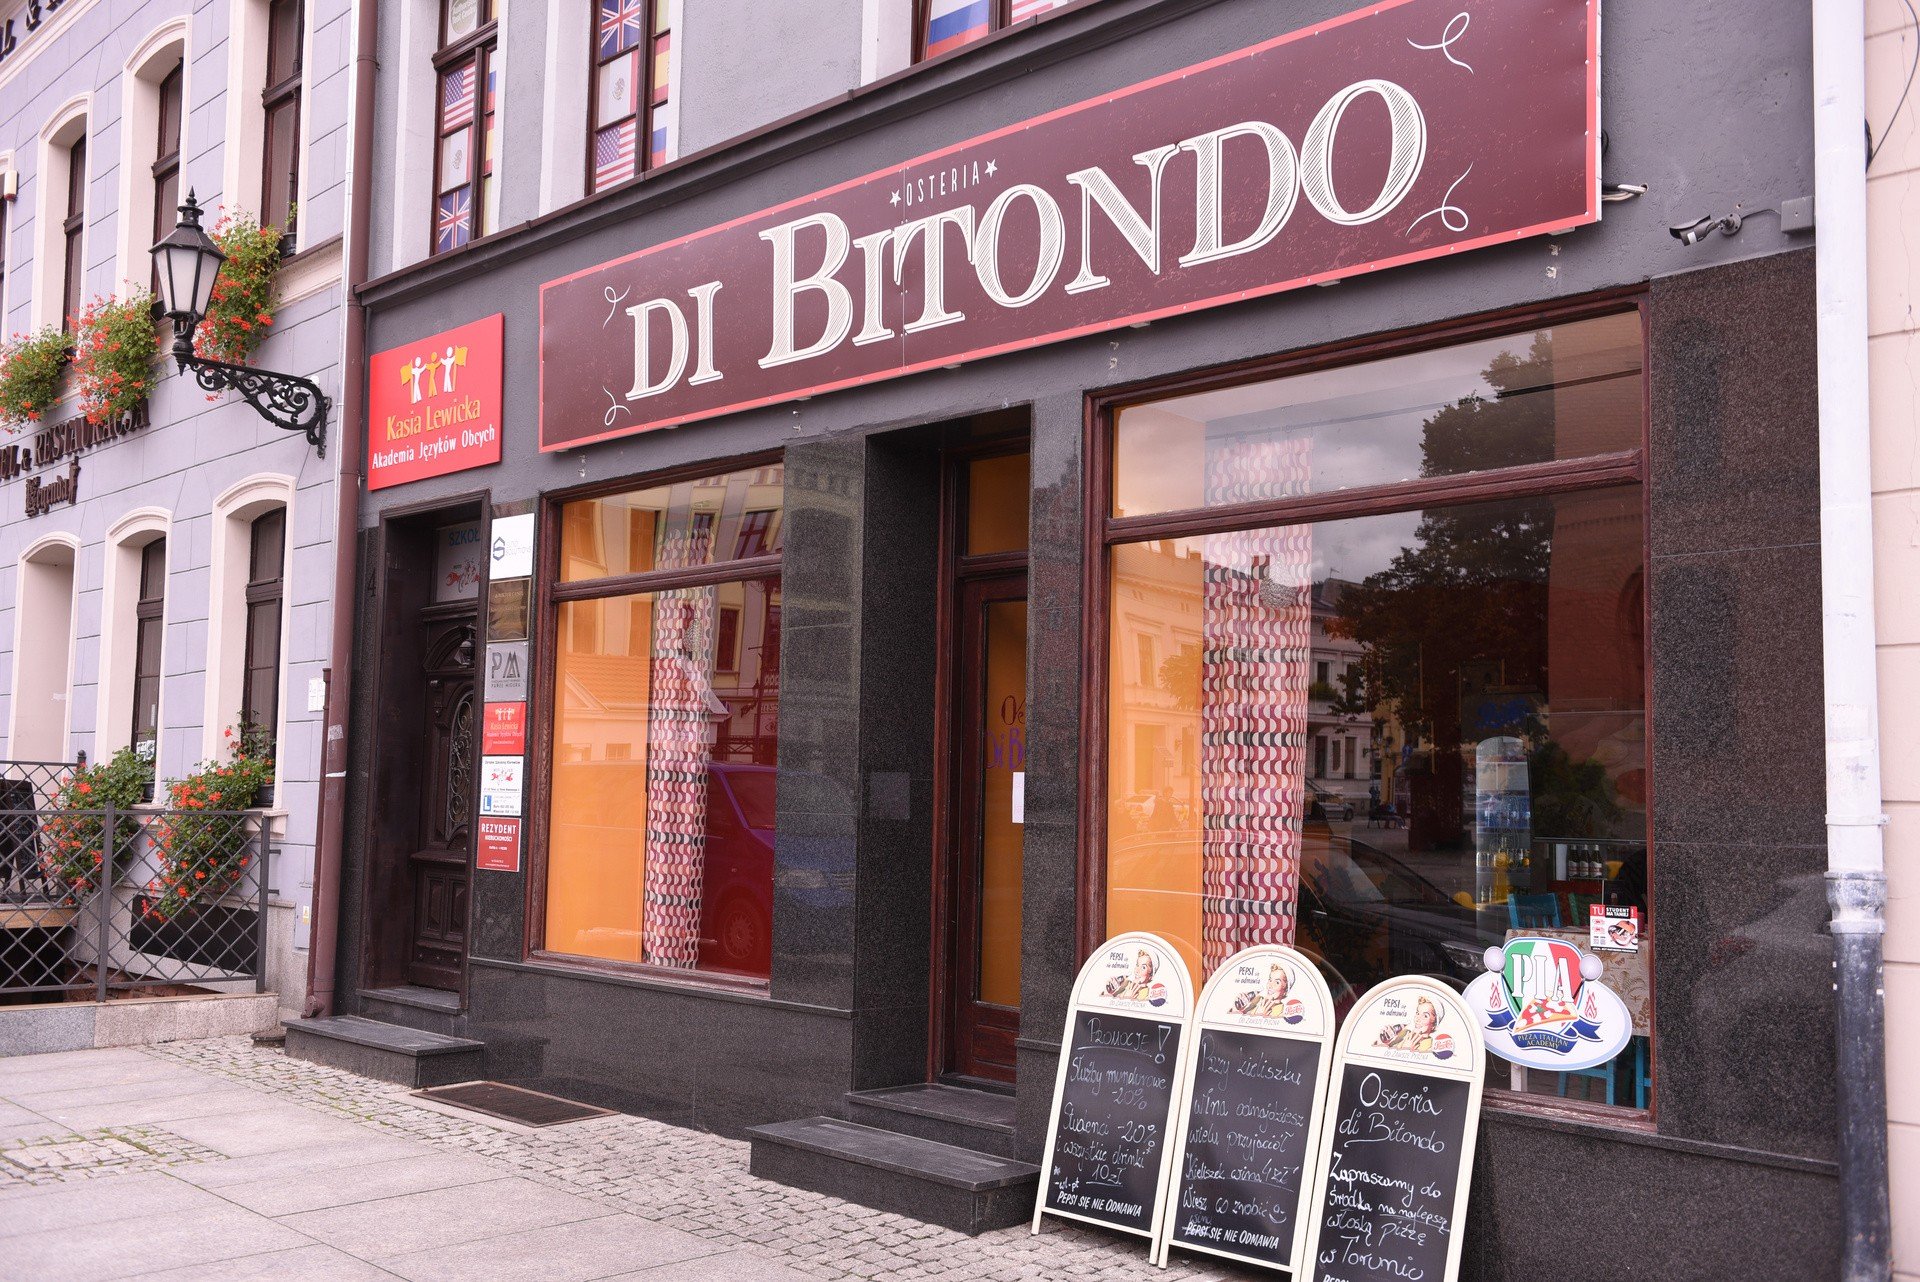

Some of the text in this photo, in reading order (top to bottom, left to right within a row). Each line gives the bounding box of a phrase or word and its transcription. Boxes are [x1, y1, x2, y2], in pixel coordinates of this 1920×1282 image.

[906, 161, 980, 207] OSTERIA
[625, 79, 1428, 401] DI BITONDO
[386, 394, 481, 441] Kasia Lewicka
[371, 423, 495, 469] Akademia Języków Obcych
[481, 823, 517, 834] REZYDENT
[1592, 906, 1604, 915] TU
[1110, 952, 1124, 961] PEPSI
[1239, 966, 1254, 976] PEPSI
[1511, 953, 1575, 1003] PIA
[1384, 998, 1400, 1009] PEPSI
[1517, 1033, 1569, 1047] PIZZA ITALIAN
[1526, 1040, 1559, 1050] ACADEMY
[1359, 1072, 1443, 1116] Osteria
[1338, 1108, 1445, 1153] di Bitondo
[1329, 1151, 1442, 1207] Zapraszamy do
[1057, 1190, 1142, 1218] PEPSI SIĘ NIE ODMAWIA
[1182, 1184, 1208, 1212] Wiesz
[1378, 1203, 1397, 1215] na
[1209, 1225, 1223, 1242] SIĘ
[1223, 1229, 1239, 1243] NIE
[1239, 1229, 1280, 1250] ODMAWIA
